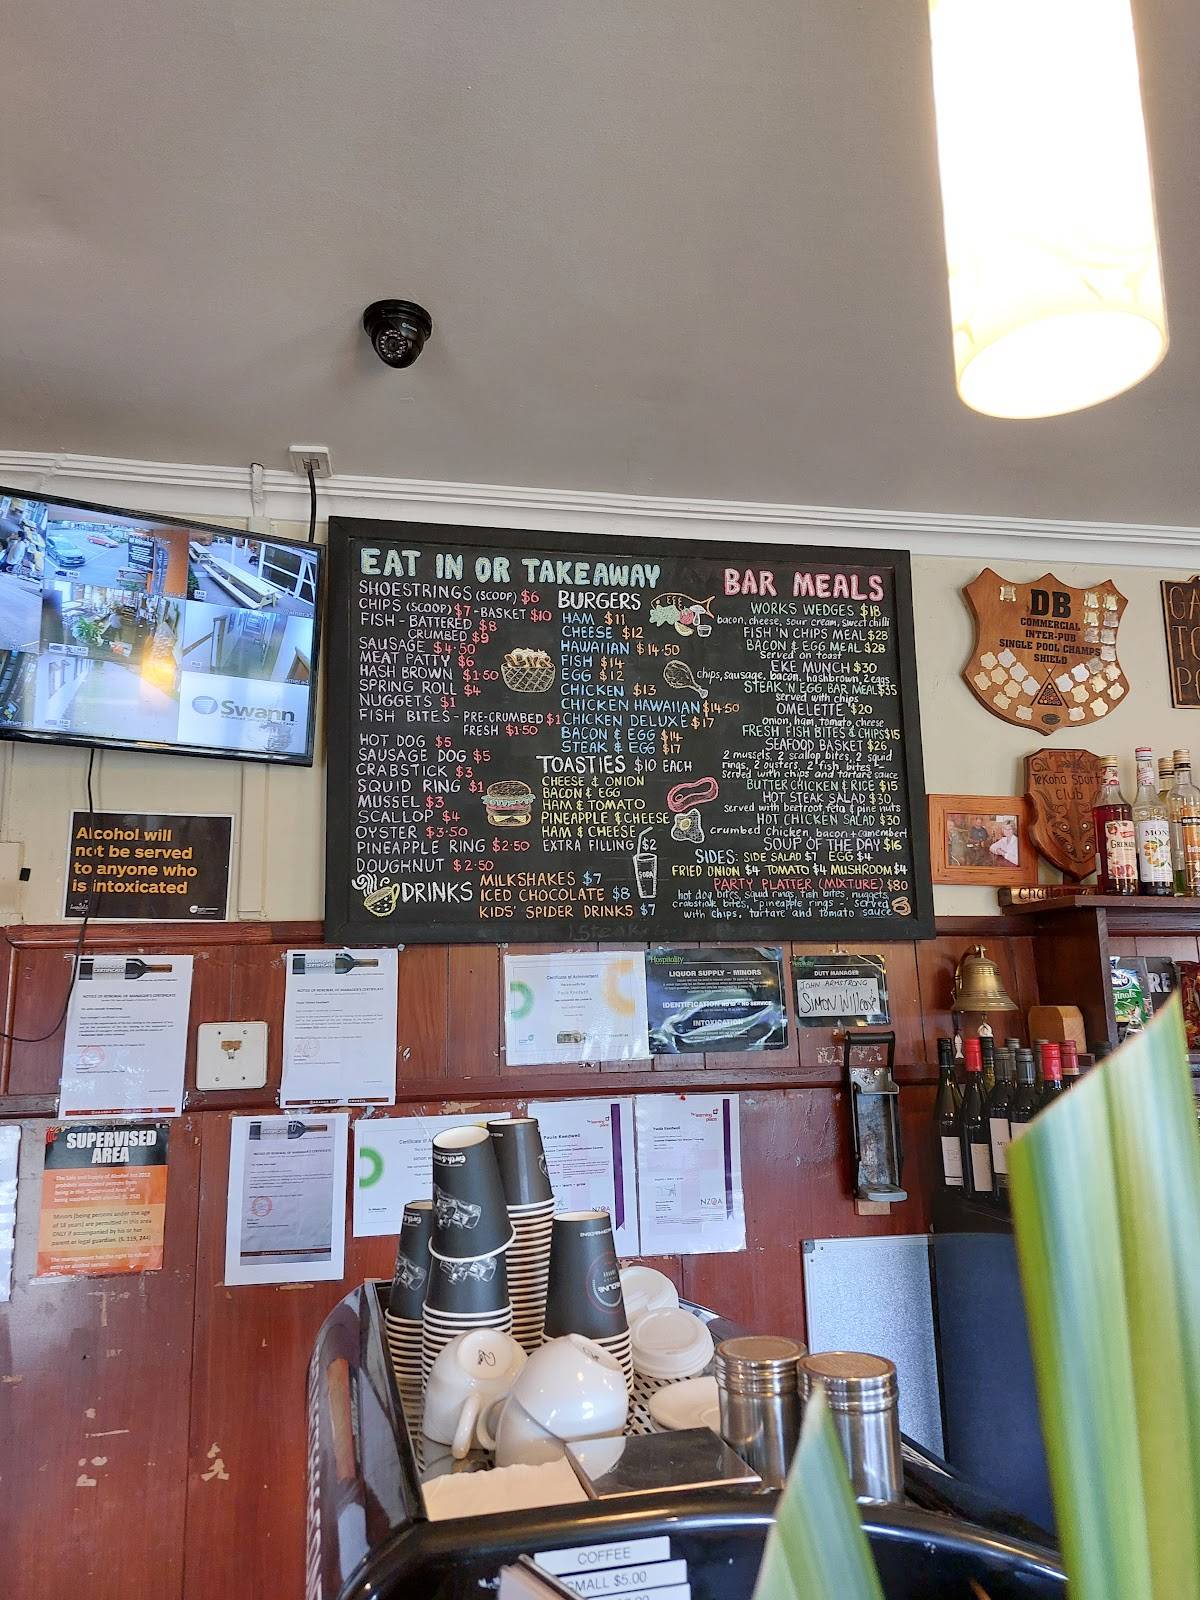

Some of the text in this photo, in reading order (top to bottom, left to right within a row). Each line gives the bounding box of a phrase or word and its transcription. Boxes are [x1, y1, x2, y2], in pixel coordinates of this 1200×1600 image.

[360, 548, 661, 589] EAT IN OR TAKEAWAY
[359, 580, 540, 604] SHOESTRINGS (SCOOP) $6
[724, 568, 883, 601] BAR MEALS
[558, 590, 641, 610] BURGERS
[1030, 589, 1071, 618] DB
[359, 598, 401, 611] CHIPS
[406, 602, 452, 614] (SCOOP)
[454, 604, 471, 618] $7
[531, 609, 552, 622] $10
[750, 602, 797, 615] WORKS
[803, 604, 854, 617] WEDGES
[361, 612, 395, 626] FISH
[410, 616, 472, 630] BATTERED
[479, 620, 497, 633] $8
[562, 611, 625, 625] HAM $11
[786, 618, 806, 626] sour
[869, 616, 889, 627] chilli
[1021, 618, 1080, 631] COMMERCIAL
[562, 626, 644, 640] CHEESE $12
[744, 627, 771, 638] FISH
[793, 628, 827, 639] CHIPS
[833, 629, 866, 641] MEAL
[868, 630, 888, 641] $28
[1025, 630, 1076, 642] INTER-PUB
[359, 637, 424, 652] SAUSAGE
[560, 640, 630, 654] HAWAIIAN
[1000, 639, 1100, 656] SINGLE POOL CHAMPS
[1034, 654, 1067, 664] SHIELD
[771, 660, 877, 674] EKE MUNCH $30
[360, 694, 456, 709] NUGGETS $1
[221, 699, 295, 722] Swann
[562, 712, 714, 729] CHICKEN DELUXE $17
[360, 734, 452, 748] HOT DOG $5
[561, 741, 608, 753] STEAK
[629, 742, 655, 754] EGG
[662, 743, 681, 755] $17
[765, 739, 887, 752] SEAFOOD BASKET $26
[356, 763, 473, 778] CRABSTICK $3
[536, 755, 692, 774] TOASTIES $10 EACH
[358, 779, 484, 794] SQUID RING $1
[542, 776, 584, 787] CHEESE
[605, 776, 644, 786] ONION
[1056, 788, 1083, 800] Club
[757, 814, 900, 826] HOT CHICKEN SALAD $30
[76, 827, 172, 842] Alcohol will
[356, 826, 417, 839] OYSTER
[109, 846, 130, 858] be
[134, 847, 193, 860] served
[357, 841, 439, 854] PINEAPPLE
[450, 838, 486, 852] RING
[74, 862, 197, 878] to anyone who
[356, 858, 444, 873] DOUGHNUT
[480, 871, 602, 887] MILKSHAKES $7
[713, 878, 908, 891] PARTY PLATTER (MIXTURE) $80
[72, 880, 187, 894] is intoxicated
[402, 881, 473, 903] DRINKS
[480, 886, 631, 903] ICED CHOCOLATE $8
[479, 903, 656, 919] KIDS' SPIDER DRINKS $7
[684, 908, 705, 918] with
[749, 908, 784, 919] tartare
[792, 907, 812, 917] and
[819, 908, 854, 918] tomato
[863, 908, 892, 917] sauce
[67, 1130, 157, 1149] SUPERVISED
[92, 1147, 130, 1163] AREA
[578, 1547, 631, 1565] COFFEE
[614, 1571, 647, 1586] $5.00
